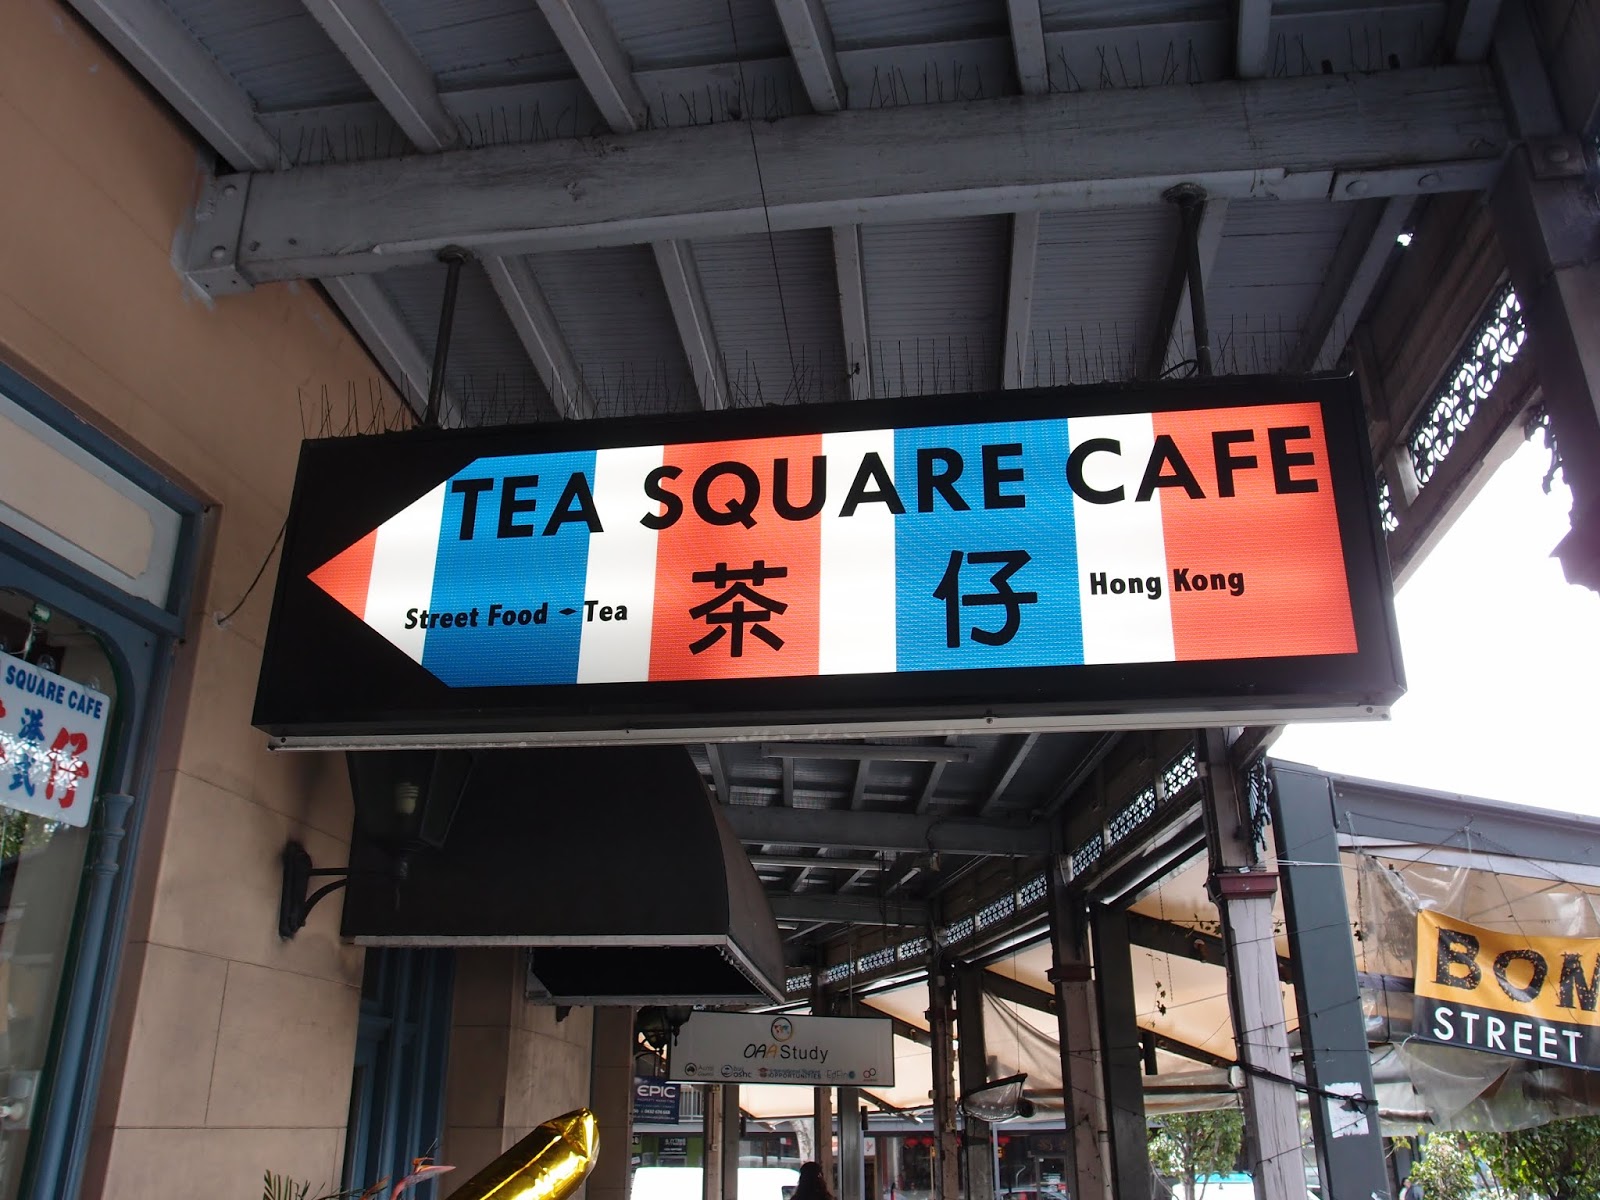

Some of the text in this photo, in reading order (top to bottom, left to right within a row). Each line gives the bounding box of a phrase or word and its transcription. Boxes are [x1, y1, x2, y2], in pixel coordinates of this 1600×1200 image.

[451, 425, 1319, 541] TEA SQUARE CAFE
[688, 549, 1038, 658] 茶 仔
[1089, 568, 1245, 600] Hong Kong
[404, 600, 628, 630] Street Food Tea
[5, 664, 103, 720] SQUARE CAFE
[45, 726, 90, 809] 仔
[1432, 1006, 1583, 1063] STREET
[637, 1085, 676, 1098] EPIC
